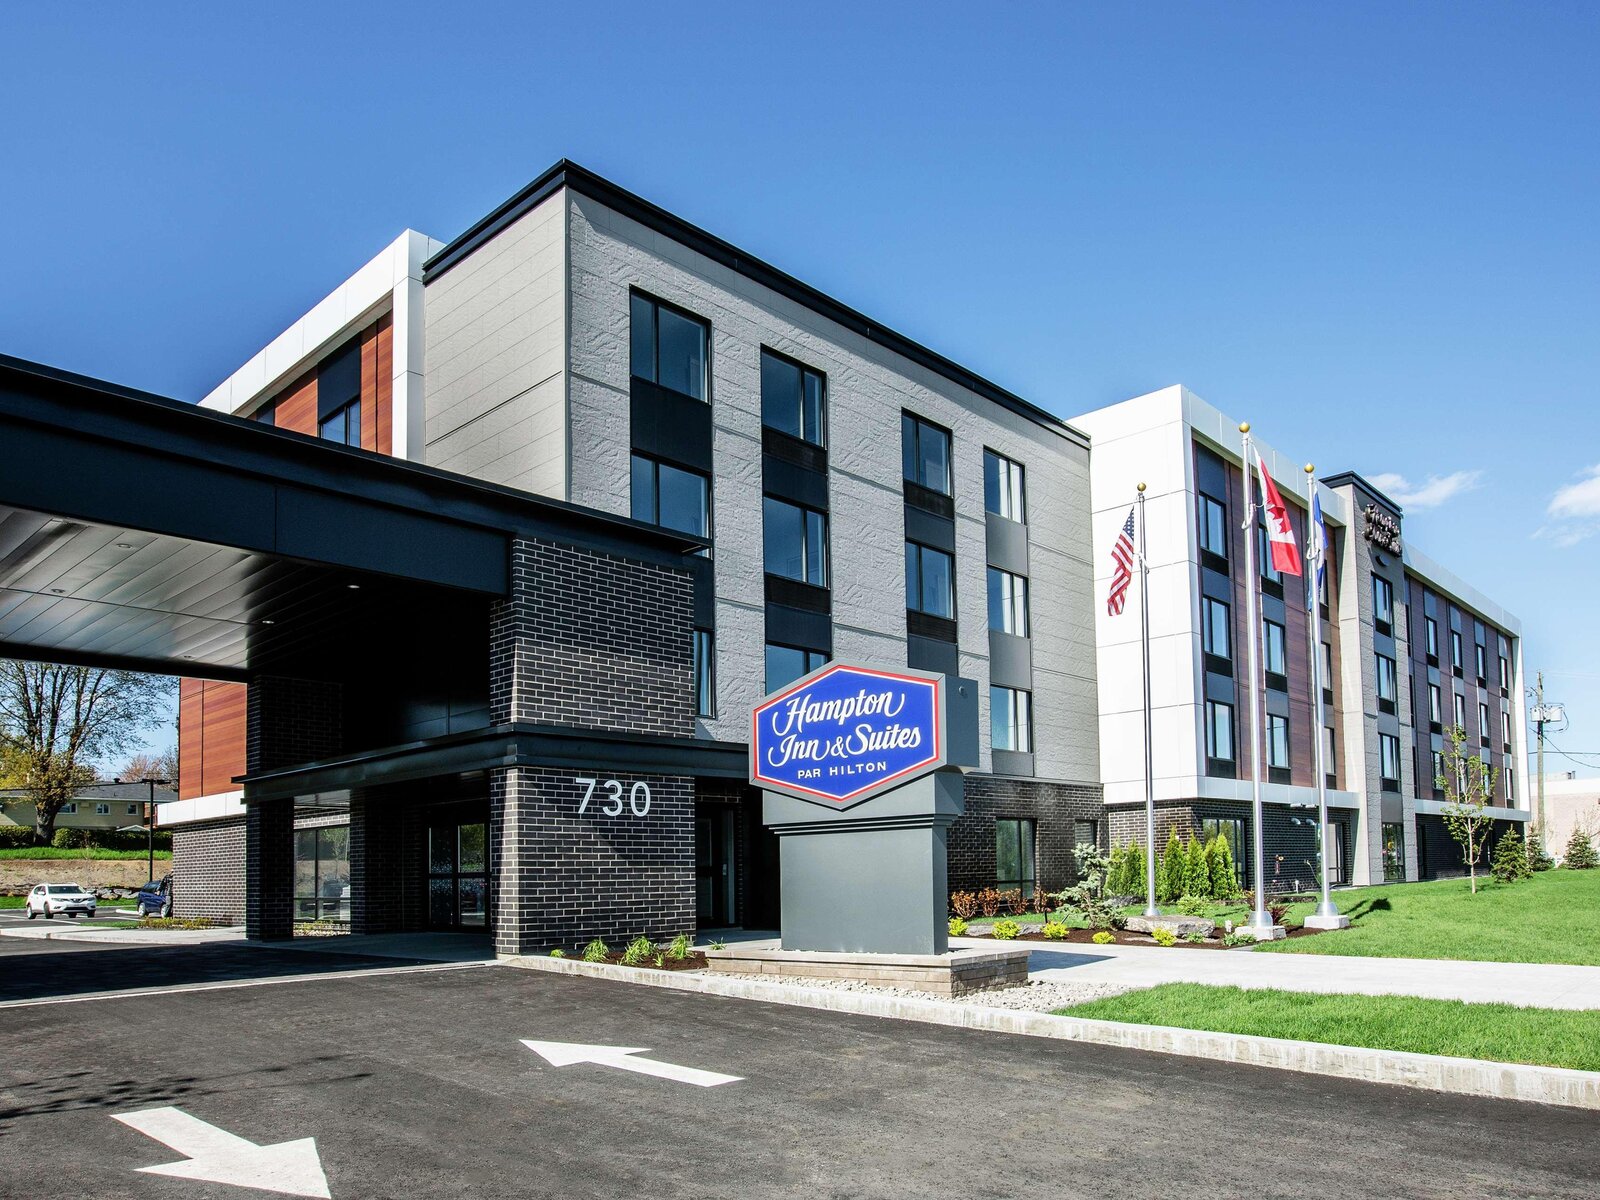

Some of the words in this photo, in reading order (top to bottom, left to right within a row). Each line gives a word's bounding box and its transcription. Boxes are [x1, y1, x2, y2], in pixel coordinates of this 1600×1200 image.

[772, 688, 906, 737] Hampton
[767, 733, 830, 767] Inn
[830, 735, 848, 759] &
[846, 723, 921, 755] Suites
[797, 768, 821, 780] PAR
[829, 761, 887, 777] HILTON
[575, 777, 651, 817] 730
